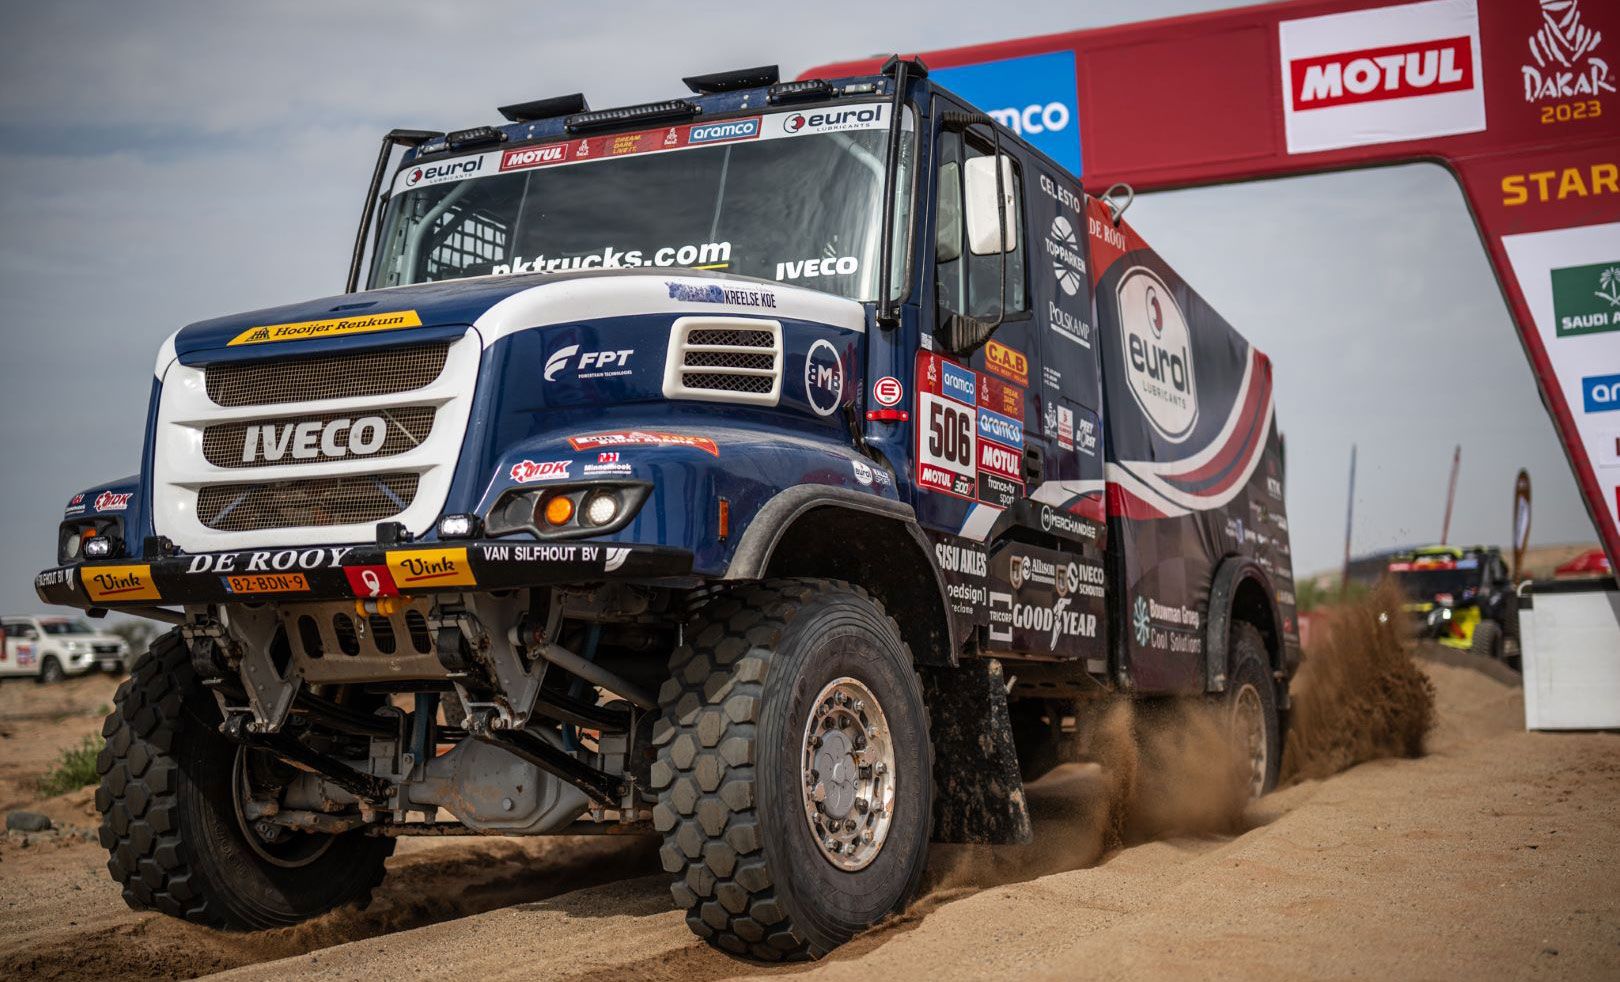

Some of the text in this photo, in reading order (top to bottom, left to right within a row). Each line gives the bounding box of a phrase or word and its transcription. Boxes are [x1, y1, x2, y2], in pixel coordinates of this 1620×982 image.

[1300, 47, 1463, 101] MOTUL
[1521, 58, 1616, 102] DAKAR
[808, 105, 882, 127] eurol
[1541, 100, 1602, 124] 2023
[694, 122, 754, 139] aramco
[817, 123, 871, 132] LUBRICANTS
[424, 156, 483, 179] eurol
[507, 147, 562, 166] MOTUL
[429, 173, 473, 184] LUBRICANTS
[1501, 163, 1620, 206] STAR
[1040, 174, 1081, 213] CELESTO
[1089, 216, 1103, 239] DE
[1045, 237, 1087, 274] TOPPARKEN
[776, 256, 859, 281] IVECO
[724, 290, 777, 309] KREELSE KOE
[273, 322, 334, 337] Hooijer
[336, 316, 404, 331] Renkum
[1050, 301, 1090, 339] POLSKAMP
[1562, 312, 1608, 330] SAUDI
[578, 349, 634, 370] FPT
[1129, 332, 1191, 395] eurol
[943, 372, 975, 395] aramco
[1142, 380, 1187, 410] LUBRICANTS
[242, 416, 387, 463] IVECO
[929, 401, 970, 467] 506
[980, 414, 1021, 443] aramco
[982, 446, 1020, 476] MOTUL
[922, 467, 952, 487] MOTUL
[186, 547, 354, 574] DE ROOY
[483, 546, 599, 562] VAN SILFHOUT BV
[935, 543, 987, 578] SISU AXLES
[400, 556, 455, 577] Vink
[1079, 563, 1105, 585] IVECO
[93, 572, 140, 591] Vink
[232, 576, 304, 593] 82-BDN-9
[989, 610, 1013, 623] TRICORP
[1151, 628, 1168, 650] Cool
